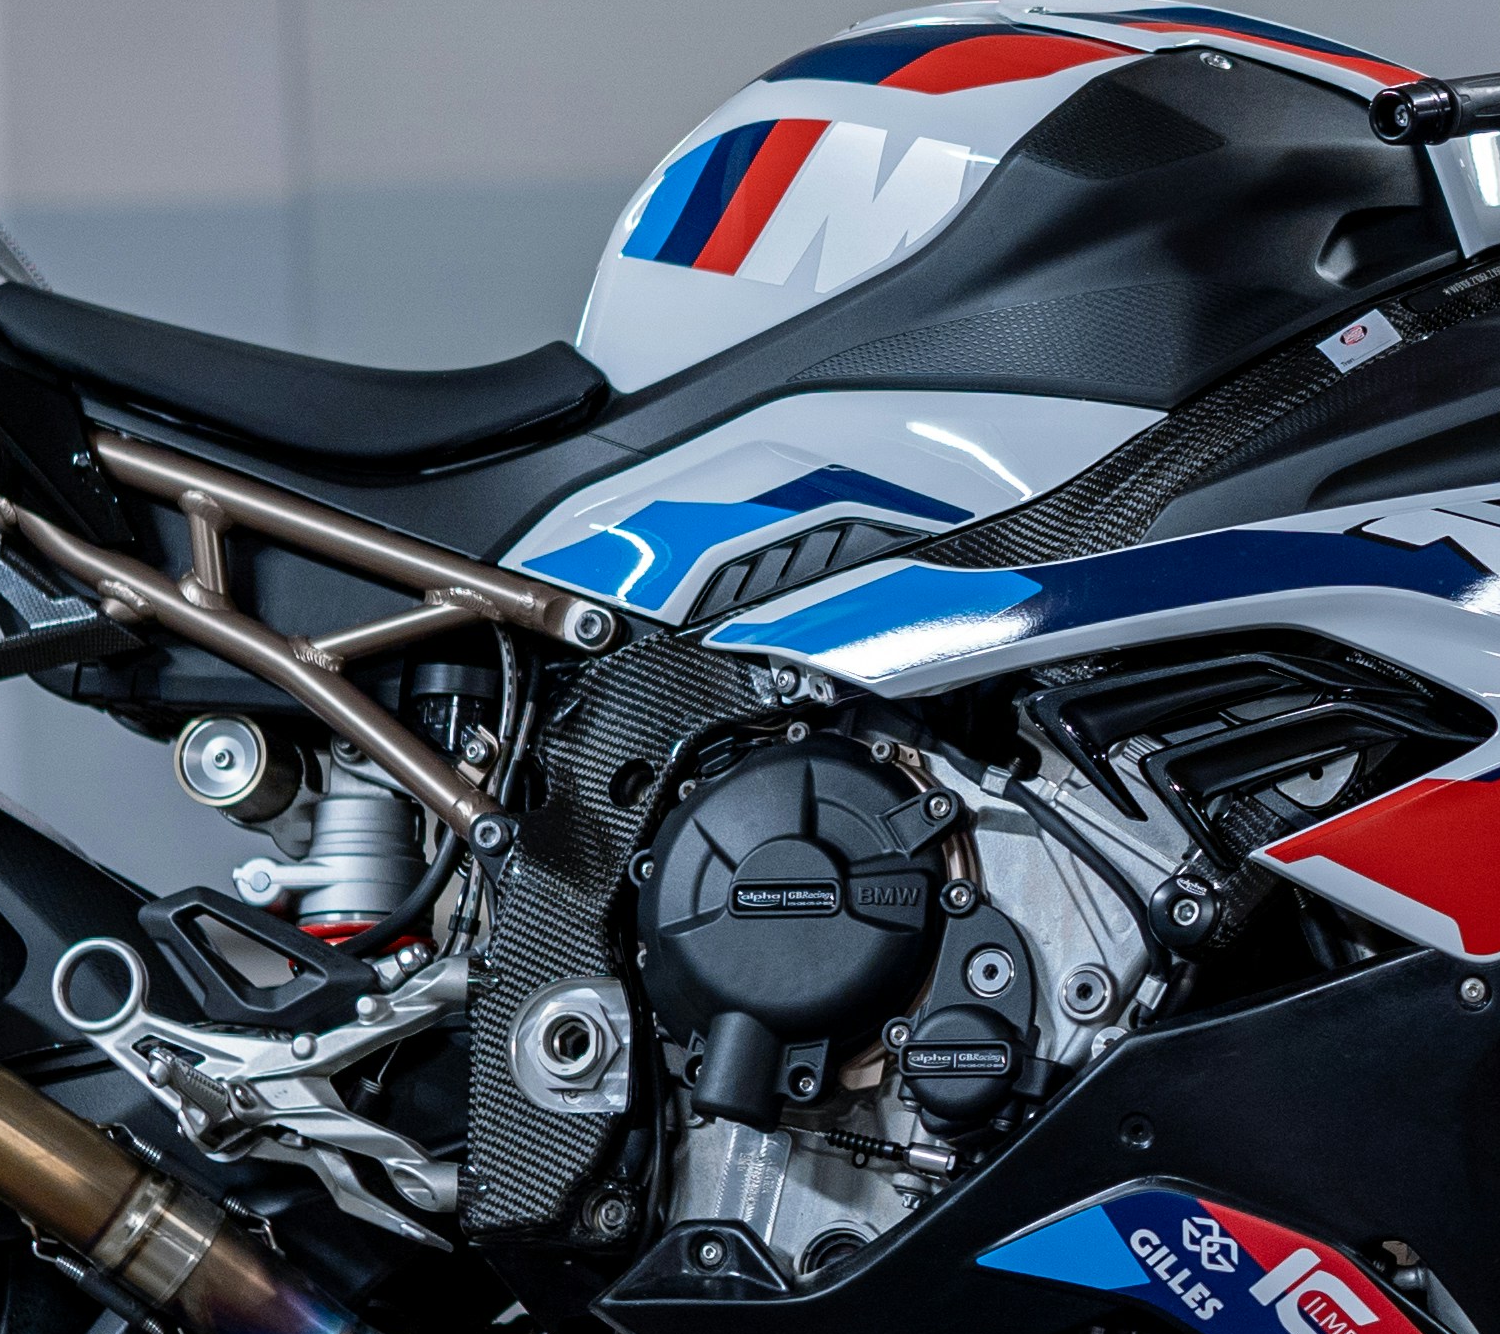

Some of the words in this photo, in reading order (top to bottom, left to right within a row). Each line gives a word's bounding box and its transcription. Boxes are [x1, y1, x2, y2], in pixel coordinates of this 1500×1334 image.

[738, 891, 781, 903] alpha
[857, 886, 920, 907] BMW
[1129, 1227, 1225, 1321] GILLES
